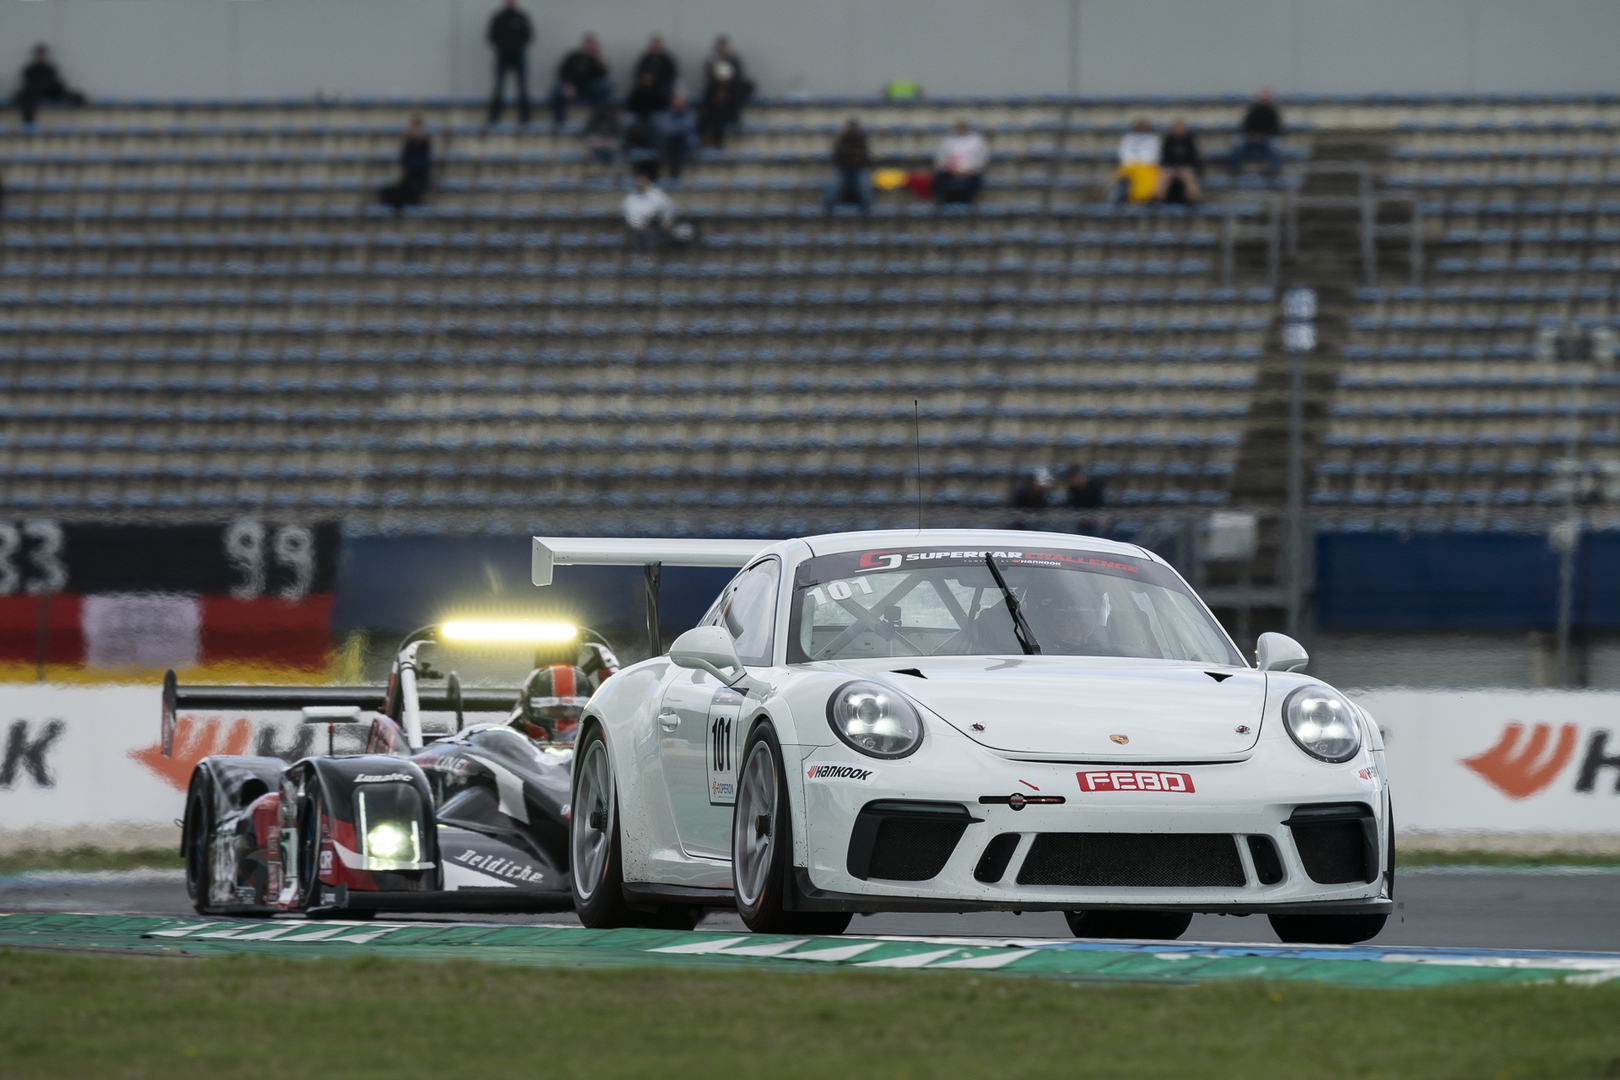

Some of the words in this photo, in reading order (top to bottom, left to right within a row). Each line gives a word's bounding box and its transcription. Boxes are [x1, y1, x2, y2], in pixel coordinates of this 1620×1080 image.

[224, 516, 315, 603] 99
[906, 551, 1023, 561] SUPERCAR
[1025, 552, 1140, 573] CHALLENGE
[807, 576, 873, 606] 101
[712, 717, 731, 772] 101
[1085, 772, 1187, 791] FEBO
[454, 849, 544, 883] Deldiche
